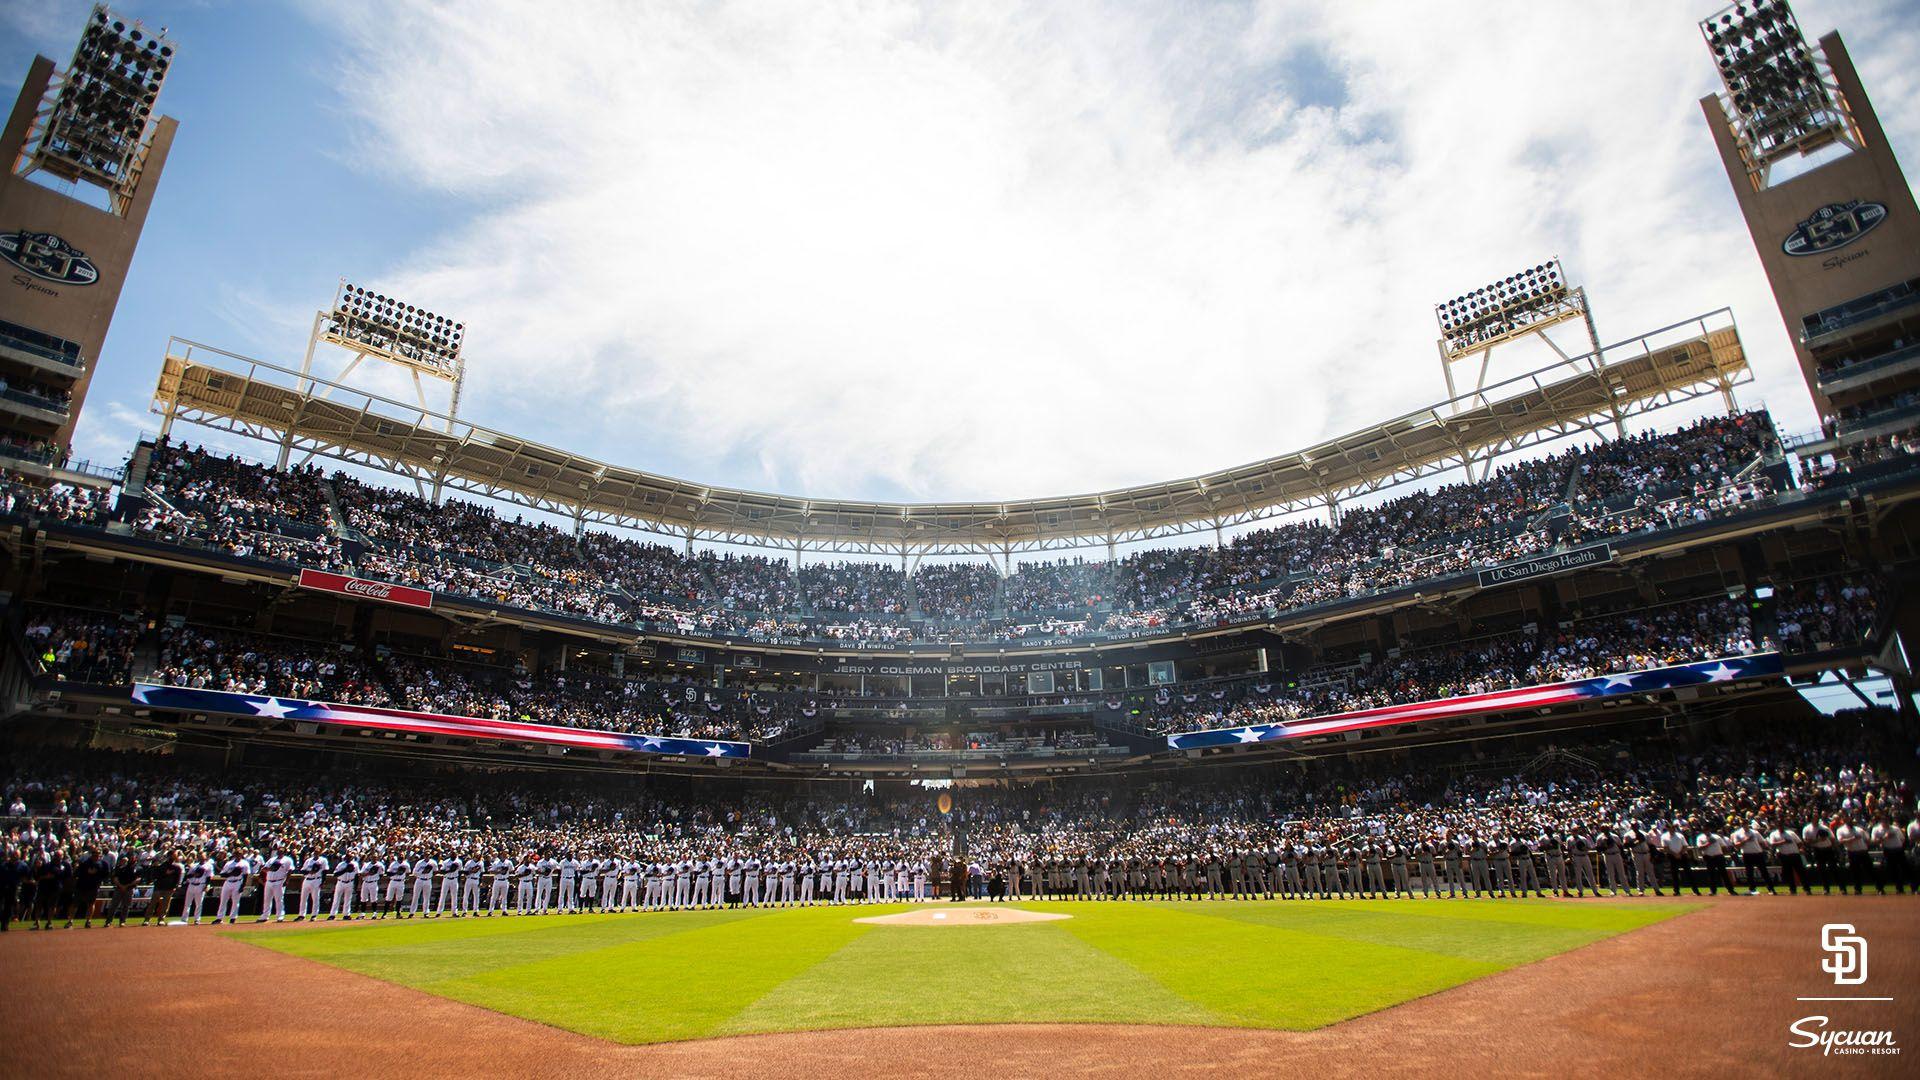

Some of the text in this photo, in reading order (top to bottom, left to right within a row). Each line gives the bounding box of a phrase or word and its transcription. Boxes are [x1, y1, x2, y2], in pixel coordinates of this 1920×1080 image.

[10, 274, 60, 297] Sycuan
[1491, 551, 1597, 581] UC San Diego Health
[1196, 621, 1217, 630] JACKIE
[1229, 614, 1261, 624] ROBINSON
[658, 626, 678, 634] STEVE
[1141, 629, 1170, 637] HOFFMAN
[770, 637, 778, 645] 19
[834, 661, 1082, 674] JERRY COLEMAN BROADCAST CENTER
[685, 687, 697, 702] SD
